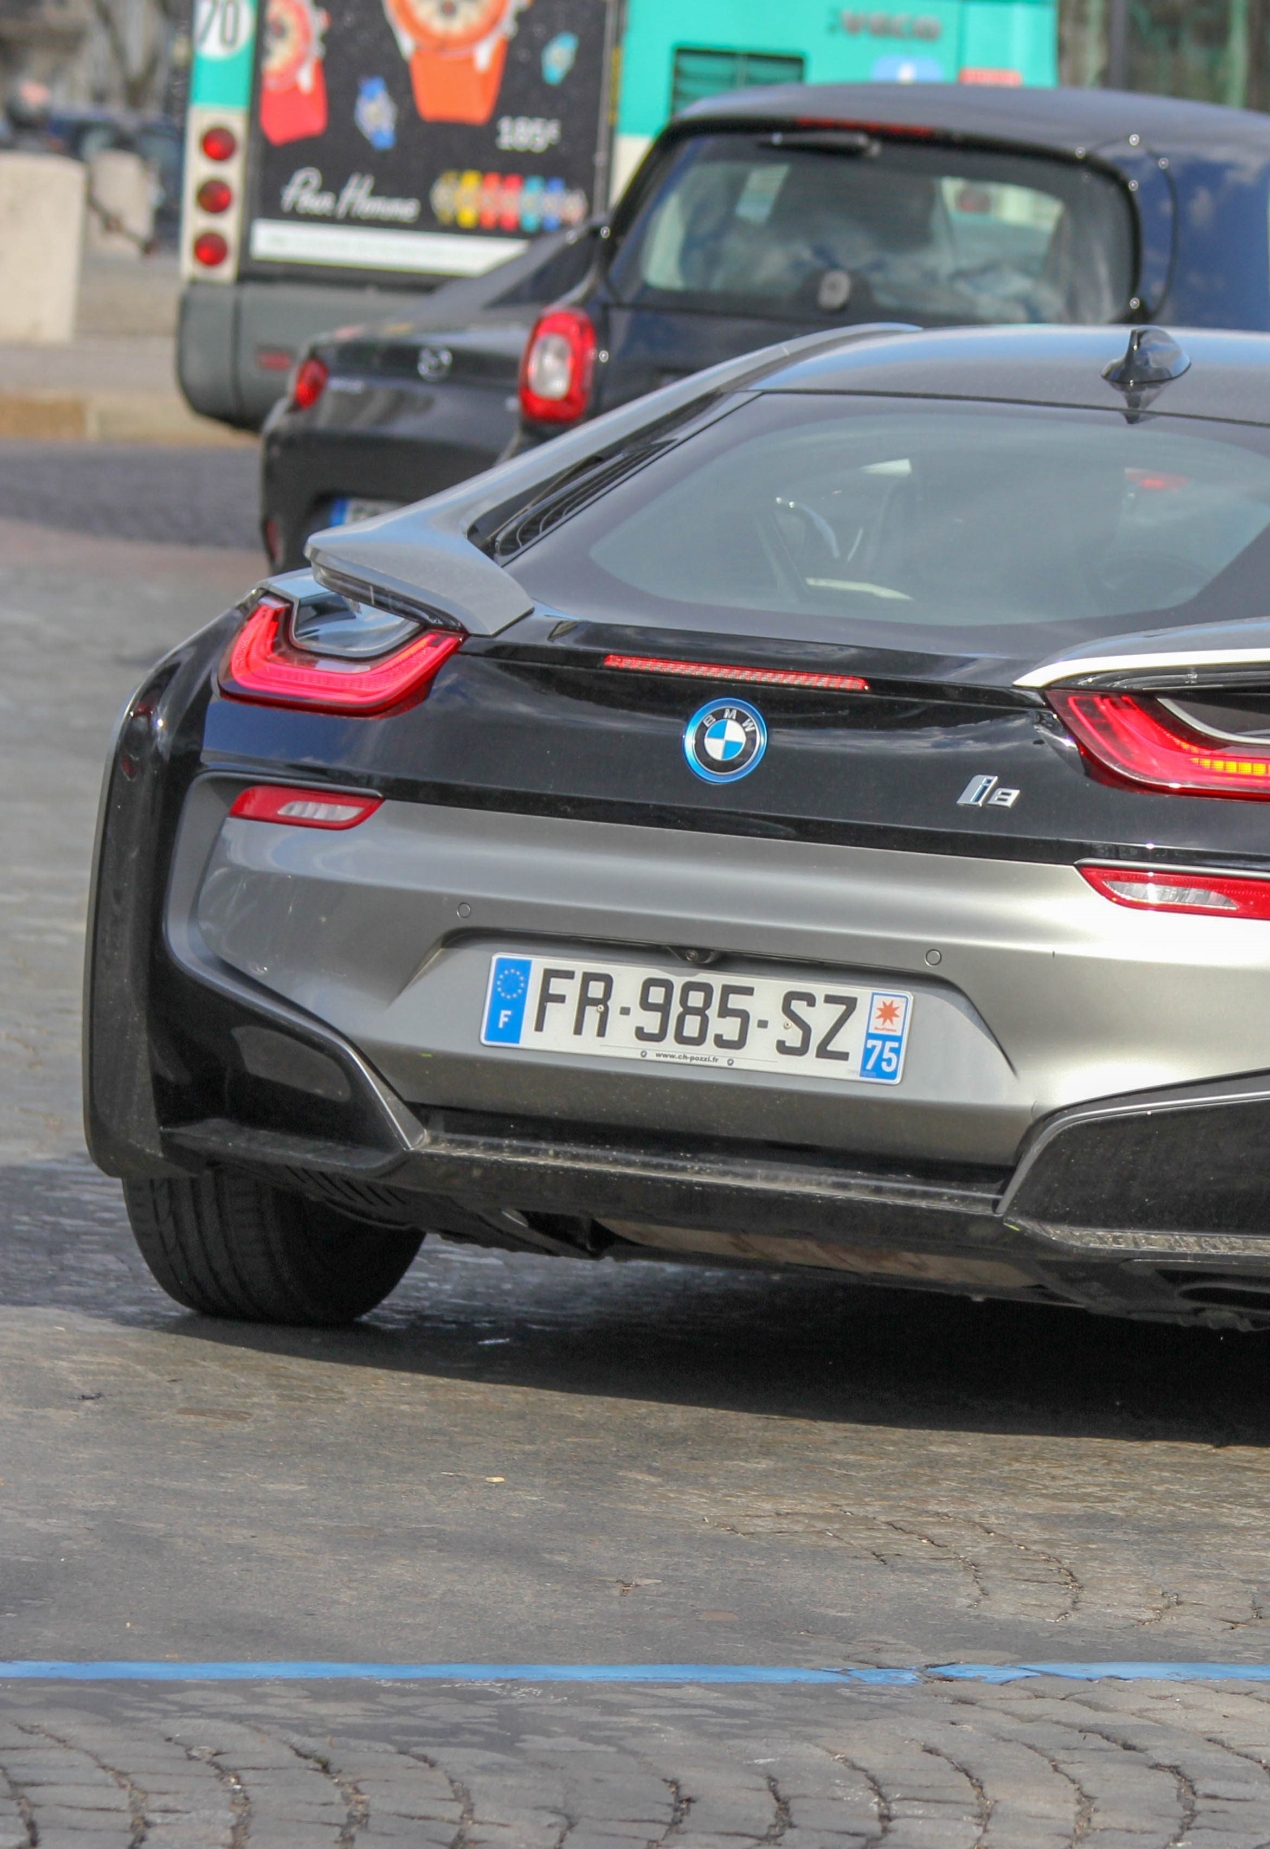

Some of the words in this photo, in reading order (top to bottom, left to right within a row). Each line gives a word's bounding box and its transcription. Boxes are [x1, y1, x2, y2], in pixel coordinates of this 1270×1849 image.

[702, 708, 756, 732] BMW
[498, 1009, 513, 1029] F
[655, 1052, 719, 1063] www.ch-pozzi.fr
[865, 1039, 900, 1073] 75
